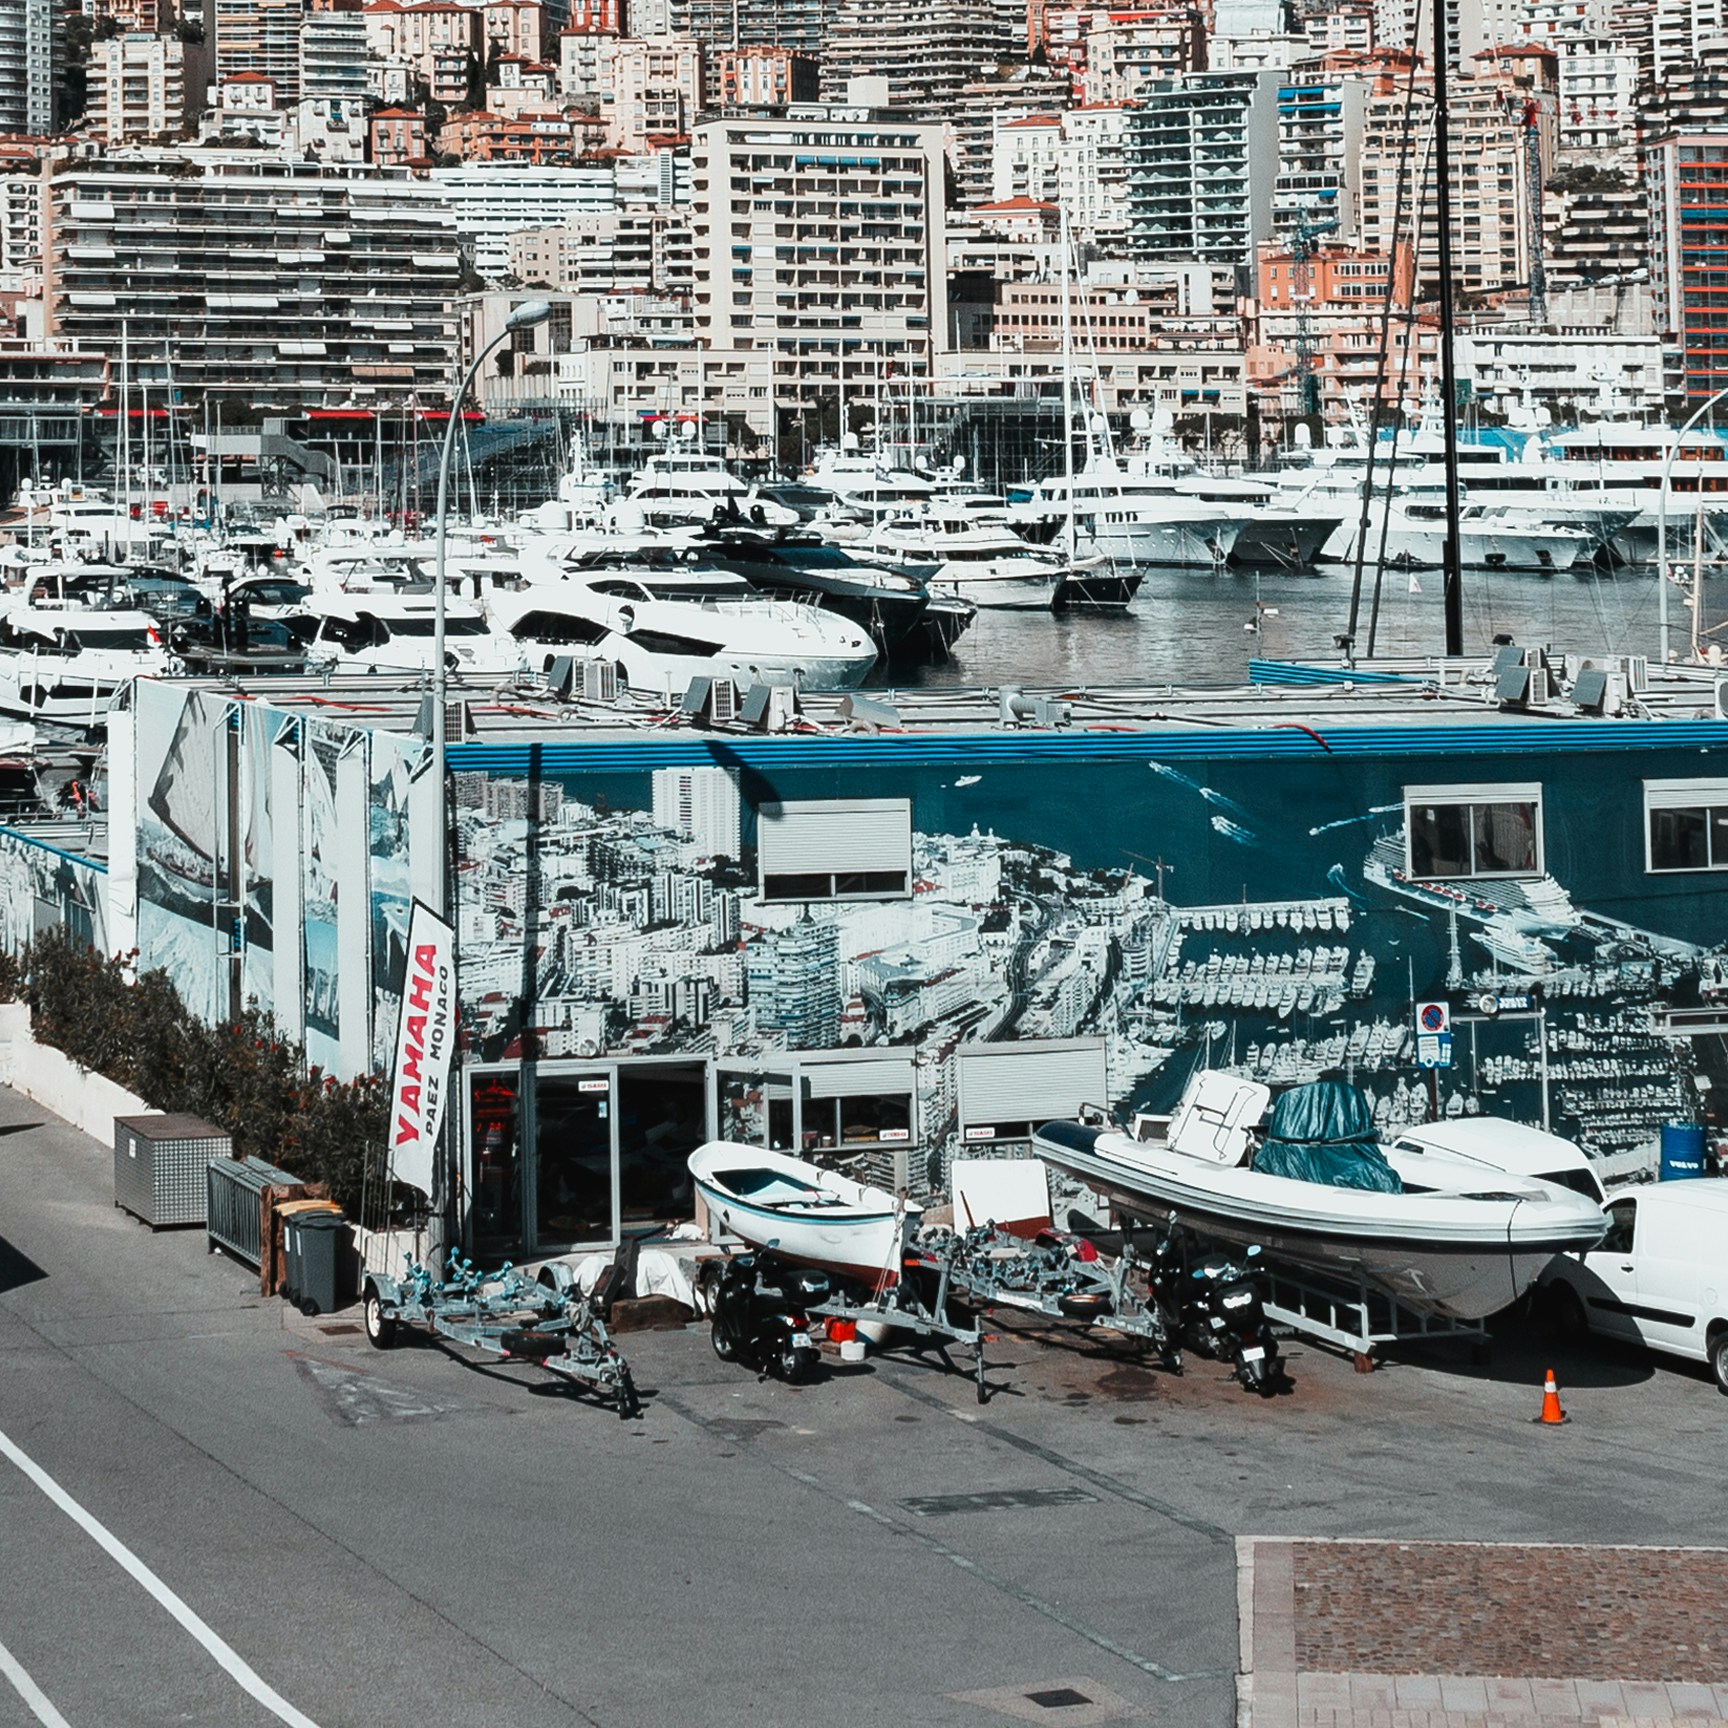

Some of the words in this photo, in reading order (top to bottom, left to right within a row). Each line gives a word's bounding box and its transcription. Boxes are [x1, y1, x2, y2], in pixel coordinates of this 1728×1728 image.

[396, 944, 437, 1146] YAMAHA
[430, 965, 449, 1061] MONACO
[425, 1077, 439, 1136] PAEZ
